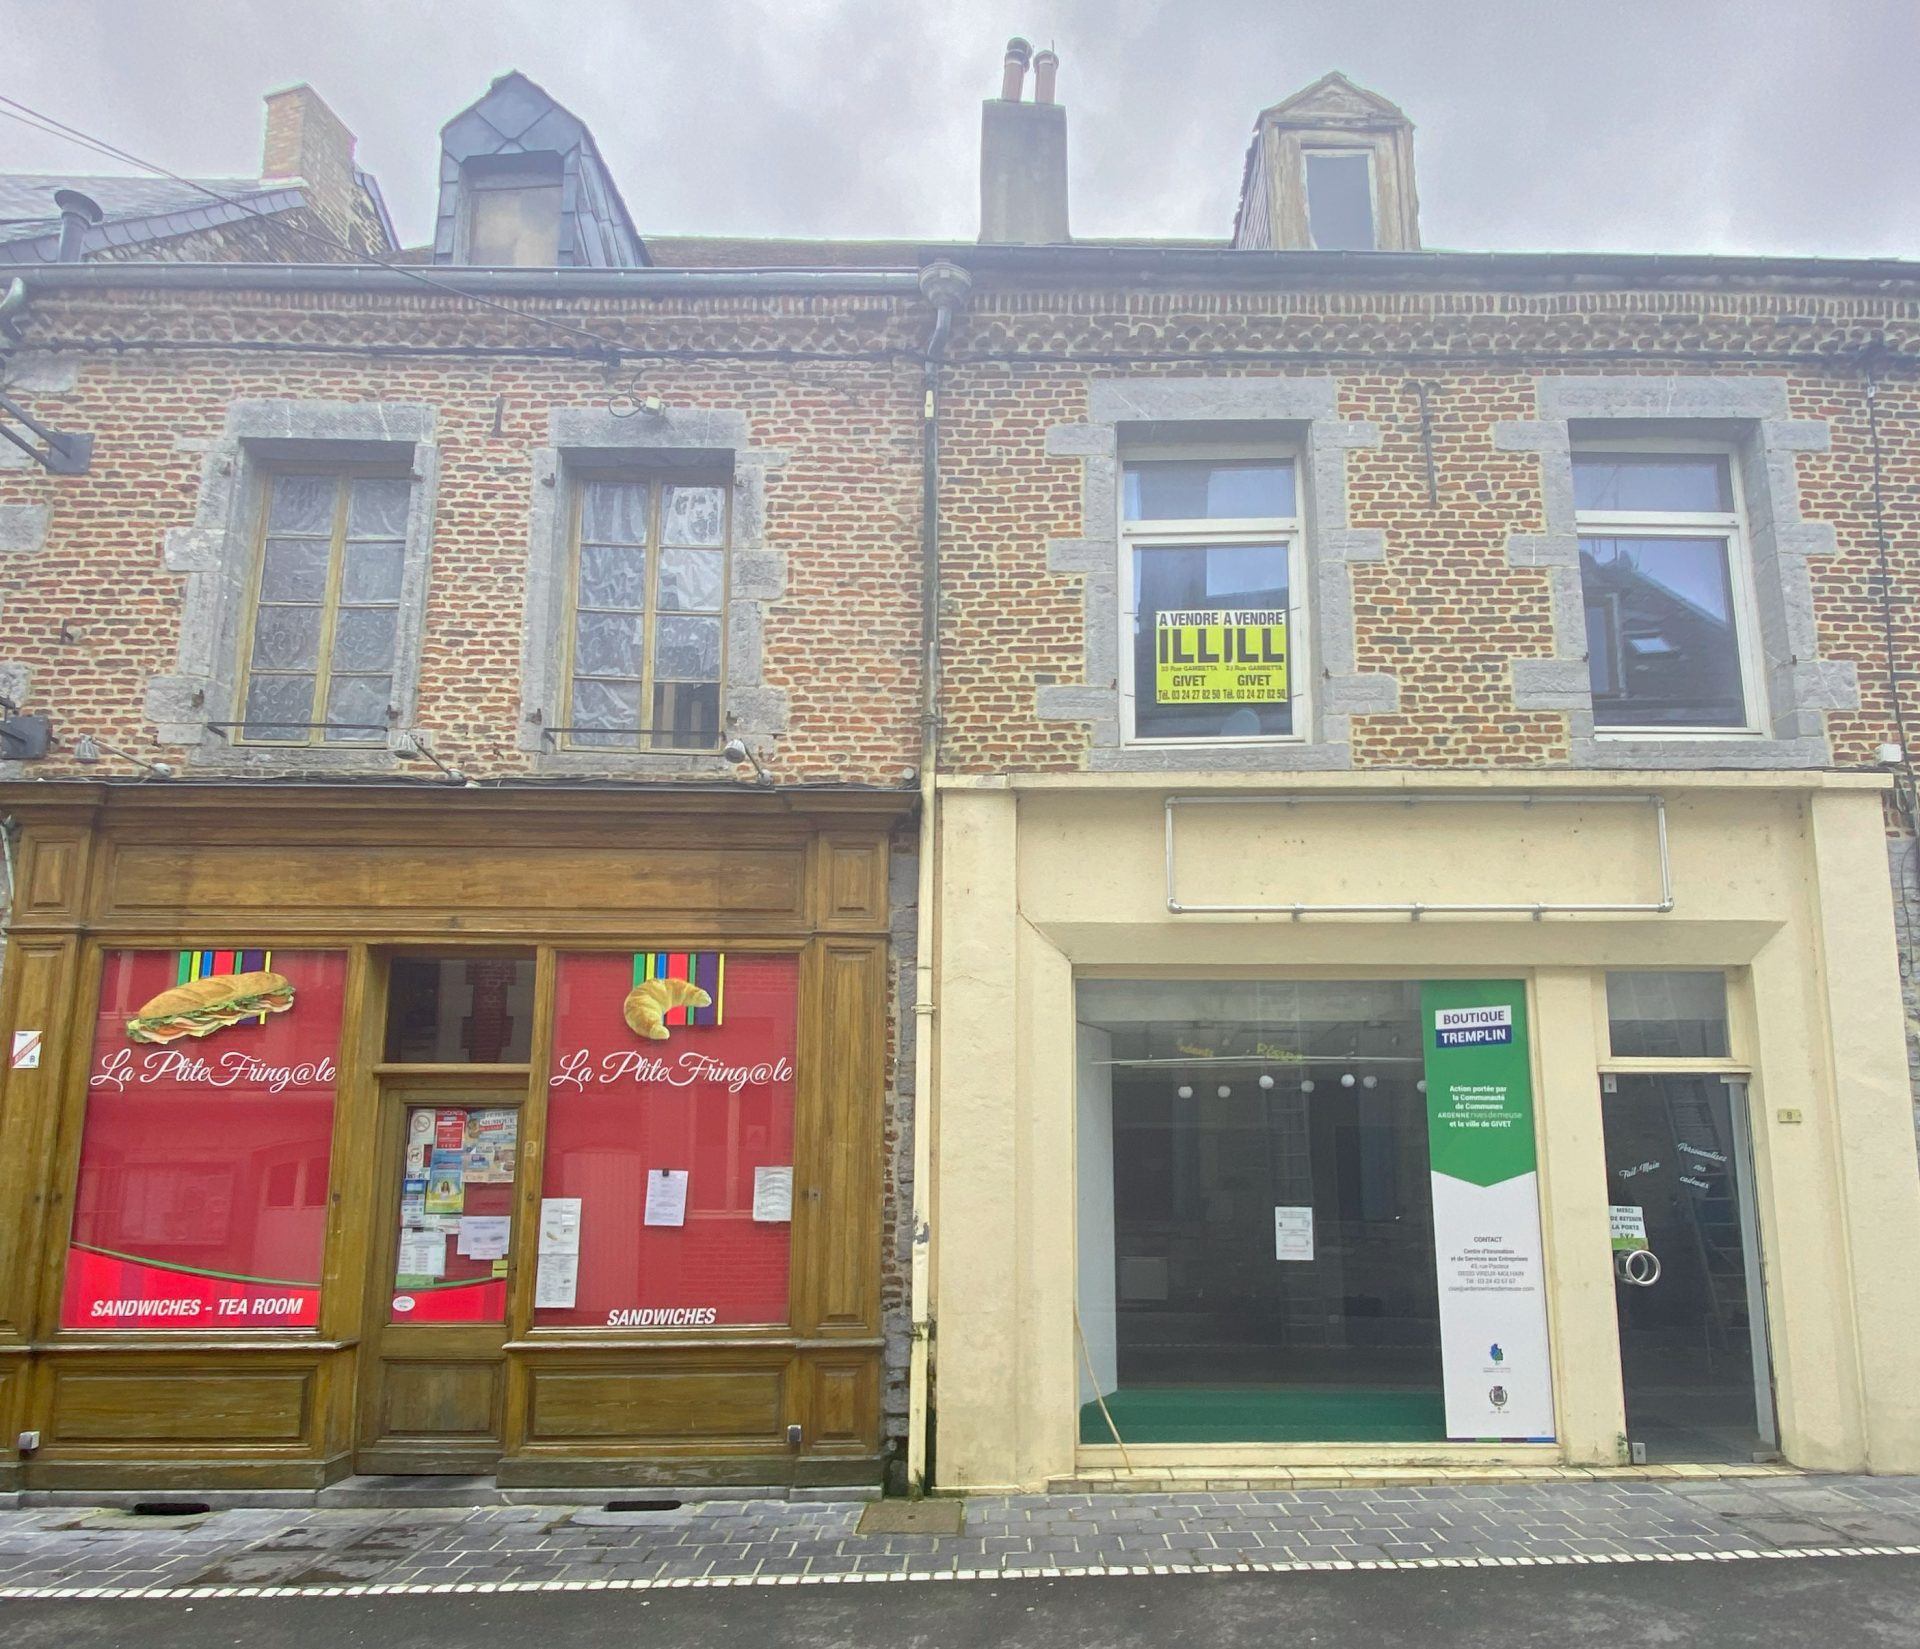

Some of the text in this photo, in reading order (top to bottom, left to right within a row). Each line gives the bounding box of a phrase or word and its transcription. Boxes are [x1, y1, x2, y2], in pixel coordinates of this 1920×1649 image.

[1159, 613, 1219, 626] A VENDRE
[1224, 612, 1283, 625] A VENDRE
[1159, 629, 1220, 664] ILL
[1223, 628, 1284, 663] ILL
[1172, 675, 1206, 687] GIVET
[1237, 674, 1271, 686] GIVET
[1171, 689, 1180, 700] 03
[1182, 689, 1190, 700] 24
[1192, 689, 1200, 699] 27
[1212, 689, 1221, 699] 50
[1236, 689, 1245, 699] 03
[1246, 689, 1255, 699] 24
[1257, 689, 1265, 699] 27
[1277, 688, 1286, 699] 50
[1443, 1010, 1505, 1025] BOUTIQUE
[1441, 1029, 1506, 1044] TREMPLIN
[90, 1048, 135, 1092] La
[207, 1051, 336, 1093] Fring@le
[549, 1048, 594, 1092] La
[667, 1052, 793, 1093] Fring@le
[1472, 1085, 1495, 1093] portée
[1495, 1086, 1507, 1094] par
[91, 1299, 202, 1317] SANDWICHES
[218, 1298, 248, 1315] TEA
[252, 1297, 304, 1315] ROOM
[607, 1308, 717, 1326] SANDWICHES
